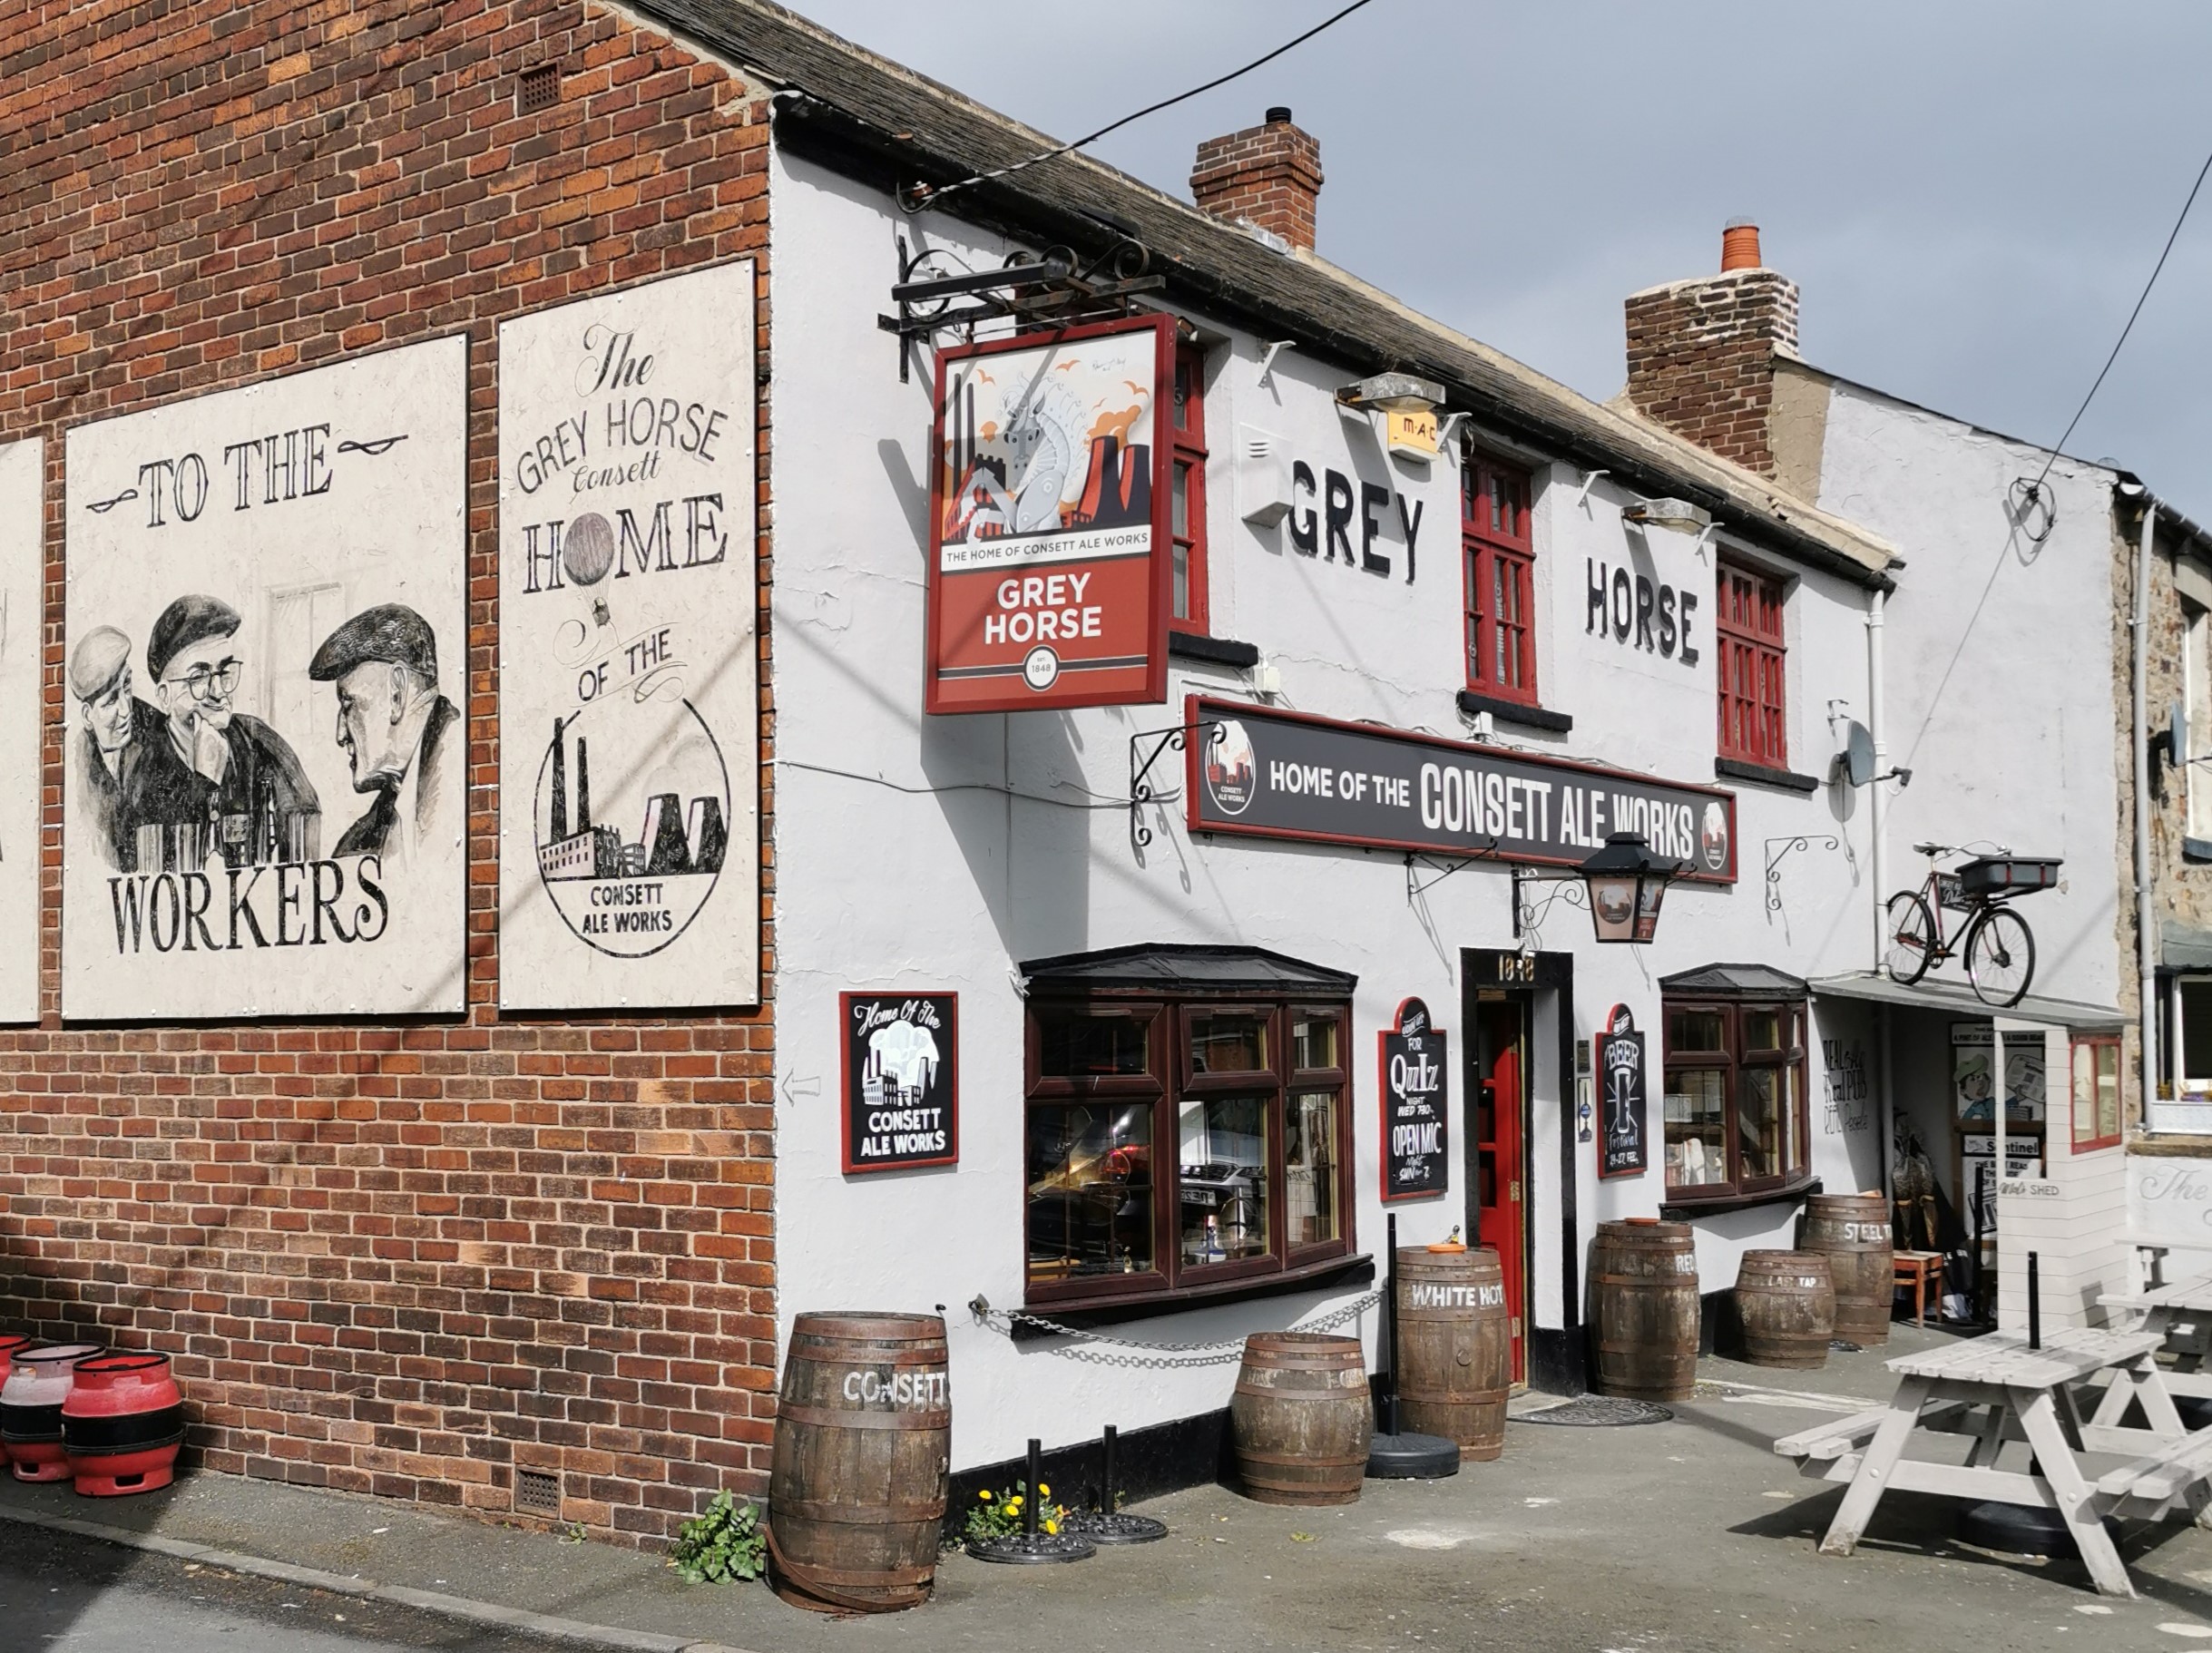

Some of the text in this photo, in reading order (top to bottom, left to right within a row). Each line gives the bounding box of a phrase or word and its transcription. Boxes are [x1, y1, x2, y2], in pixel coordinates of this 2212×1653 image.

[574, 324, 654, 397] The
[517, 397, 729, 494] GREY HORSE
[139, 423, 334, 528] TO THE
[572, 449, 661, 497] Consett
[1287, 459, 1424, 583] GREY
[946, 532, 1149, 562] THE HOME OF CONSETT ALE WORKS
[997, 572, 1091, 611] GREY
[984, 606, 1102, 645] HORSE
[1587, 556, 1699, 663] HORSE
[579, 629, 673, 702] OF THE
[1032, 663, 1052, 673] 1848
[1269, 760, 1695, 860] HOME OF THE CONSETT ALE WORKS
[107, 854, 389, 954] WORKERS
[590, 882, 664, 907] CONSETT
[582, 909, 673, 934] ALE WORKS
[854, 1002, 898, 1037] Home
[1408, 1037, 1422, 1051] FOR
[1609, 1039, 1639, 1071] BEER
[1397, 1105, 1415, 1117] WED
[1406, 1096, 1426, 1106] NIGHT
[868, 1107, 942, 1133] CONSETT
[860, 1130, 946, 1157] ALE WORKS
[1393, 1121, 1443, 1157] OPEN MIC
[1987, 1141, 2038, 1154] Sntinel
[1399, 1167, 1415, 1181] SUN
[2030, 1184, 2060, 1196] SHED
[2139, 1164, 2208, 1201] The
[1411, 1283, 1504, 1309] WHITE HOT
[843, 1370, 947, 1405] CONSETT
